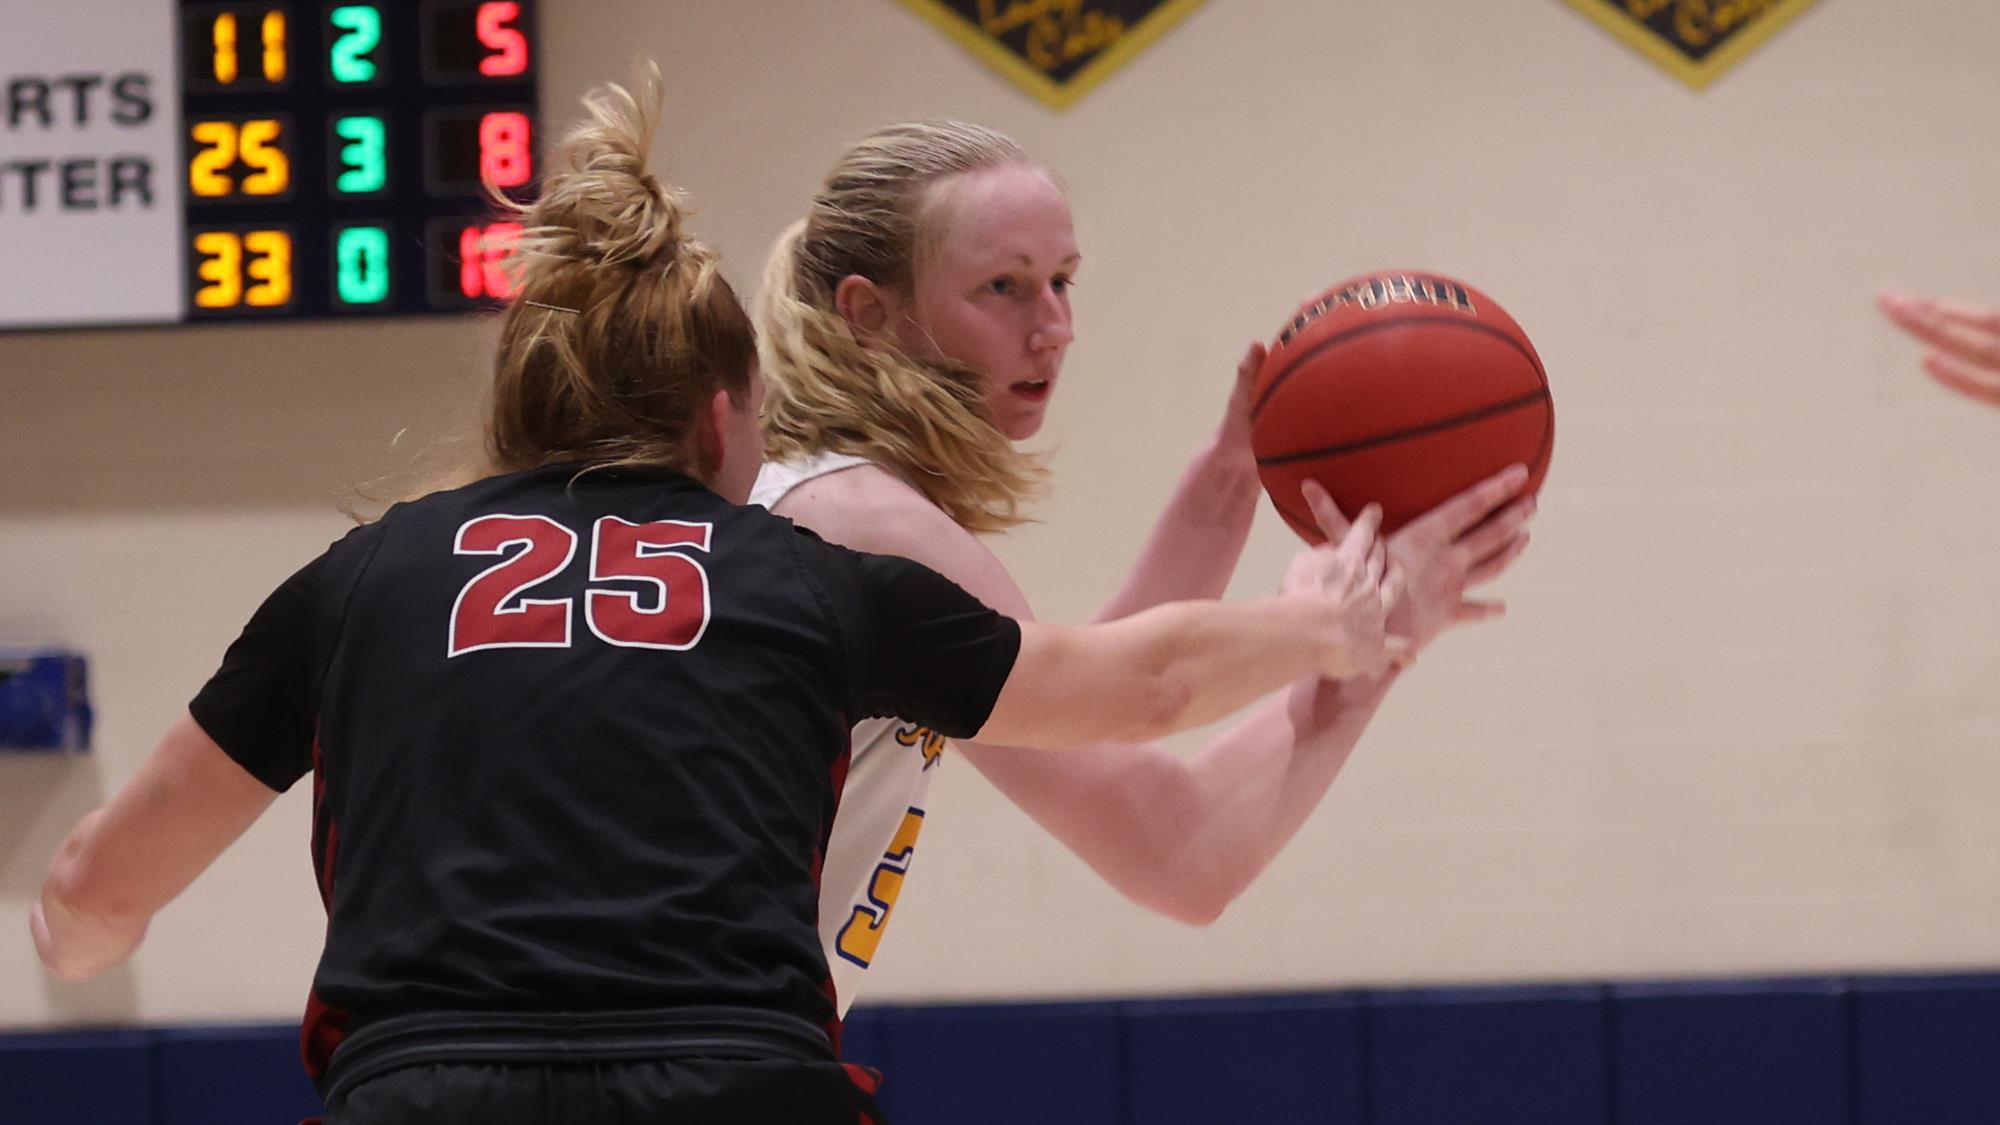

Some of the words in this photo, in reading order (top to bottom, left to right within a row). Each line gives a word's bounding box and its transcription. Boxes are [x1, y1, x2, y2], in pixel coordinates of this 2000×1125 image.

[211, 10, 288, 84] 11
[330, 5, 381, 83] 2
[475, 0, 529, 77] 5
[189, 119, 290, 197] 25
[336, 116, 386, 193] 3
[478, 111, 533, 188] 8
[193, 230, 293, 309] 33
[337, 226, 389, 304] 0
[447, 513, 713, 659] 25
